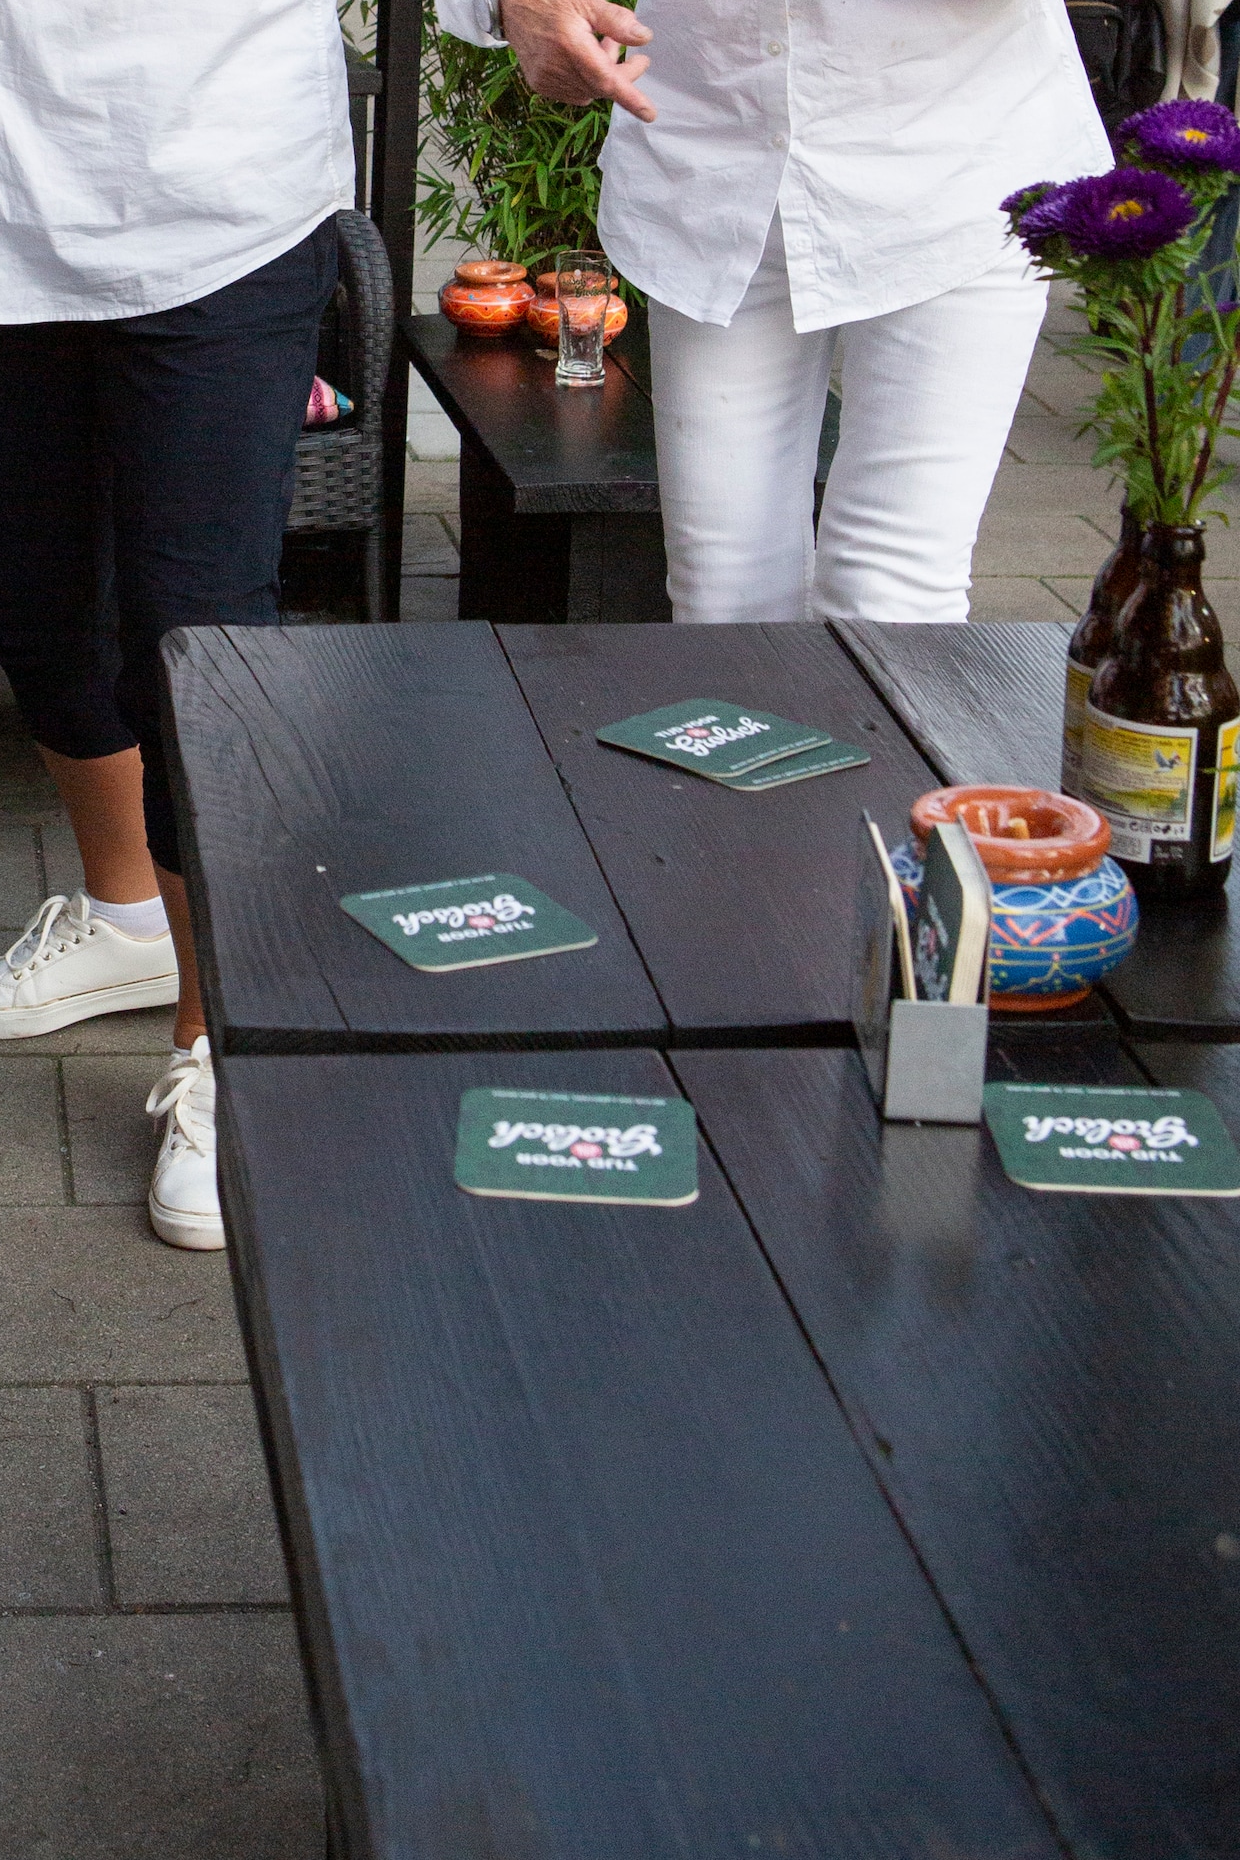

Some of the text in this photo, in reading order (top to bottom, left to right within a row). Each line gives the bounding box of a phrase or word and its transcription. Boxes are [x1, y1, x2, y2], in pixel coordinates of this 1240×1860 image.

[665, 716, 770, 757] Grolsch
[392, 894, 535, 936] Grolsch
[437, 926, 493, 942] VOOR
[488, 1120, 663, 1157] Grolsch
[1022, 1115, 1199, 1148] Grolsch
[515, 1152, 581, 1168] VOOR
[1059, 1146, 1127, 1161] VOOR
